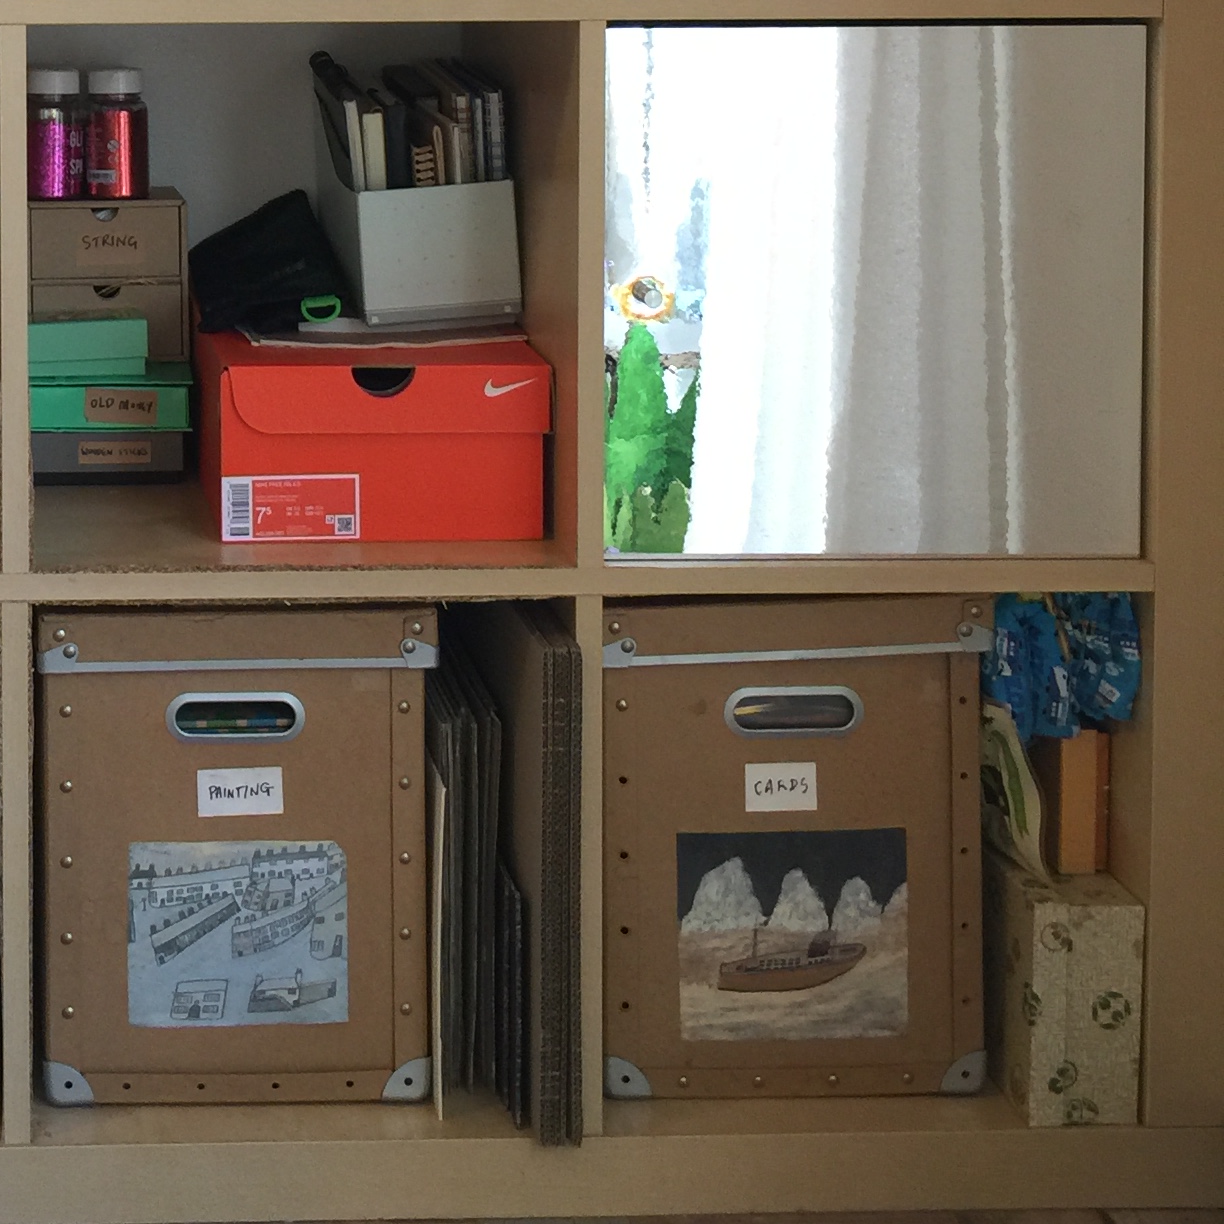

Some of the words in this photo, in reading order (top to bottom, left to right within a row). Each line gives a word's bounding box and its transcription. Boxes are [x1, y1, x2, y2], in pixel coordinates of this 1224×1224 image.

[81, 233, 139, 251] STRING
[90, 397, 115, 409] OLD
[207, 782, 274, 801] PAINTING
[753, 778, 810, 796] CARDS
